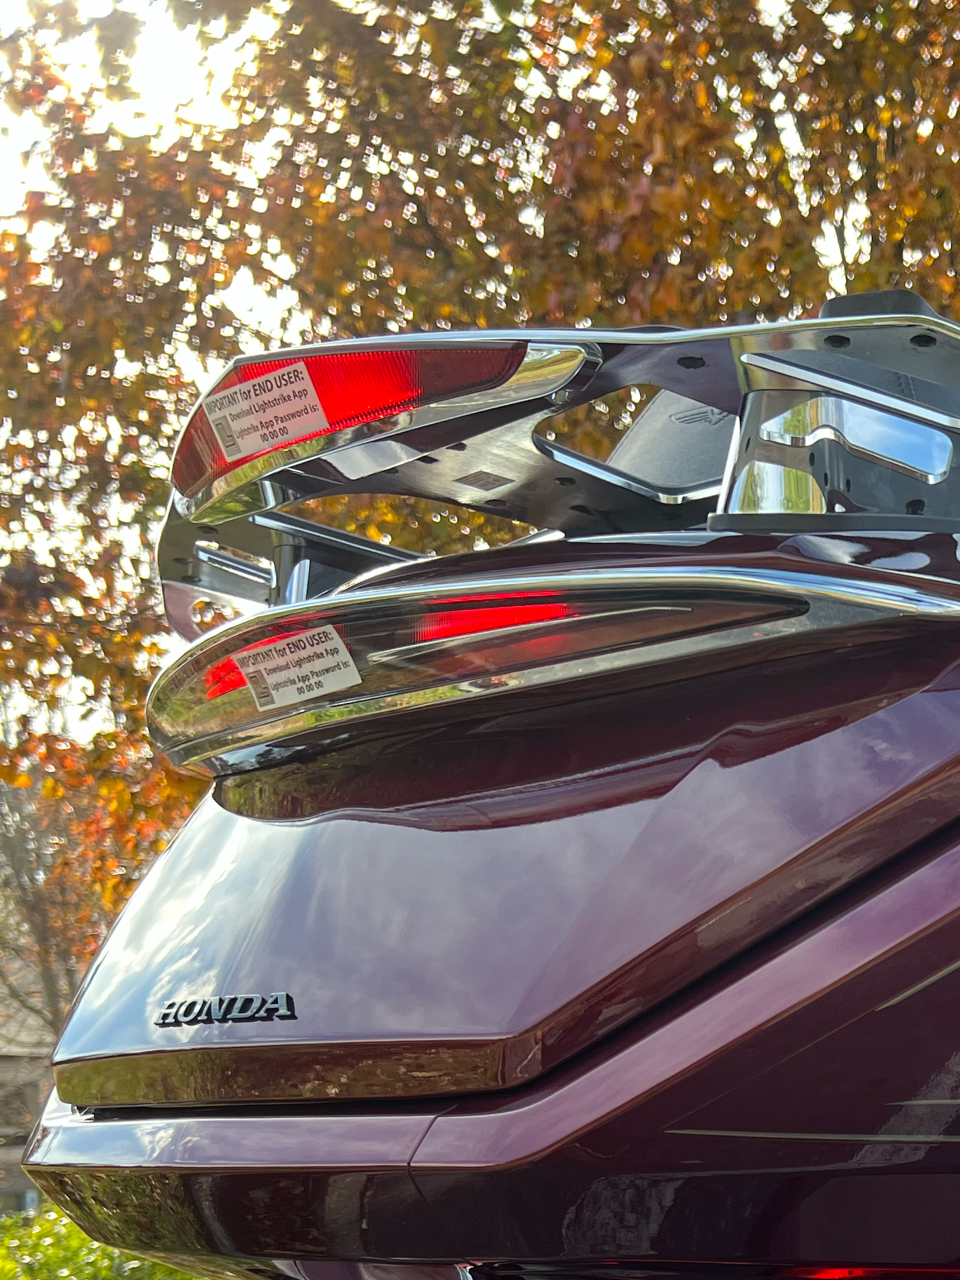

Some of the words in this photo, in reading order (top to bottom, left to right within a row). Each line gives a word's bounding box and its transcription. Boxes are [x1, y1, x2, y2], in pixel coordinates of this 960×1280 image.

[240, 388, 252, 403] for
[252, 380, 274, 397] END
[274, 369, 305, 388] USER:
[253, 393, 292, 413] Lightstrike
[292, 388, 309, 402] App
[259, 419, 275, 431] App
[274, 408, 309, 424] Password
[309, 403, 319, 413] is:
[275, 644, 288, 658] for
[287, 639, 307, 654] END
[307, 631, 334, 648] USER:
[325, 646, 340, 657] App
[297, 674, 311, 685] App
[311, 663, 341, 678] Password
[341, 659, 351, 669] is:
[154, 991, 298, 1028] HONDA
